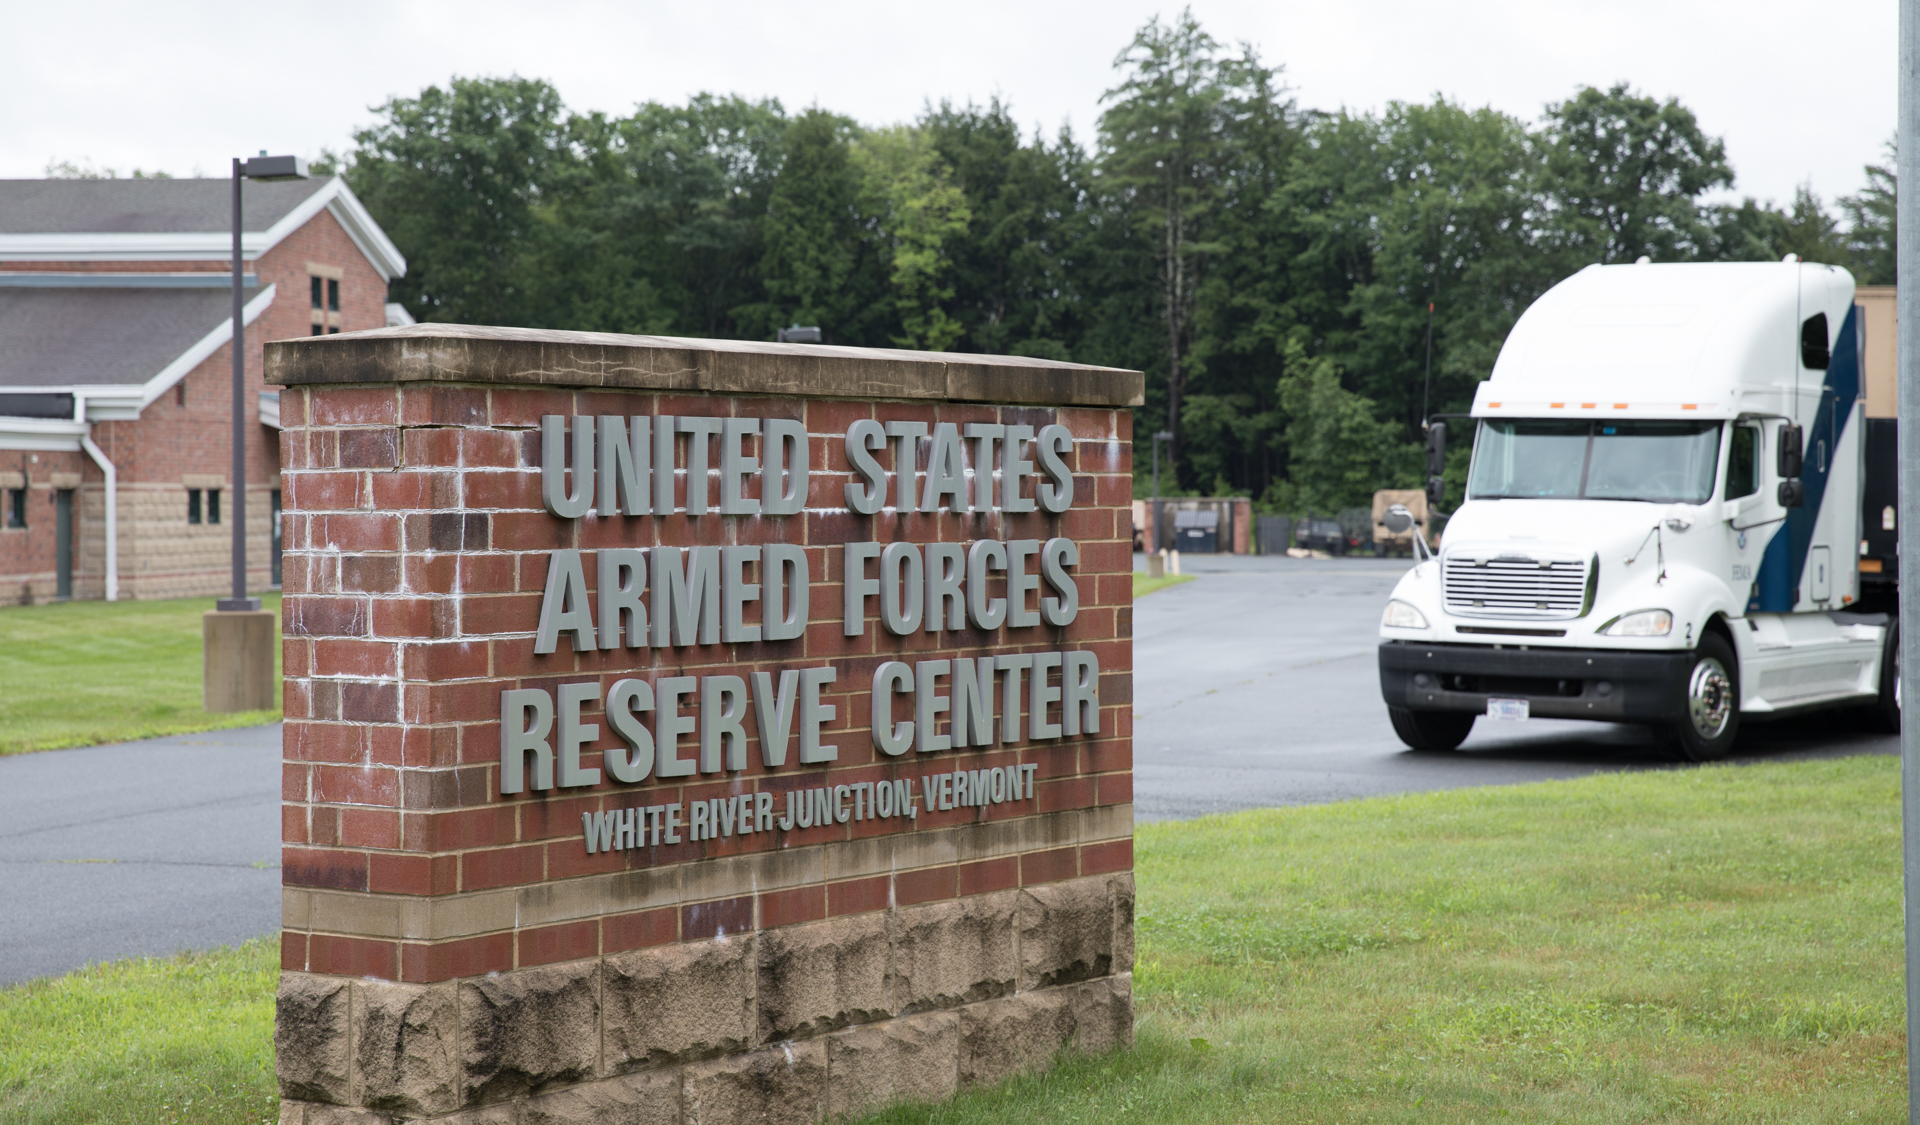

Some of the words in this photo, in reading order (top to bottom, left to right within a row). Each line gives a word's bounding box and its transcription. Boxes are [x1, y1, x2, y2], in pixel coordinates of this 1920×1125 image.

[541, 414, 810, 519] UNITED
[844, 419, 1074, 515] STATES
[534, 543, 810, 655] ARMED
[844, 537, 1079, 636] FORCES
[500, 666, 838, 795] RESERVE
[872, 651, 1100, 756] CENTER
[582, 802, 682, 854] WHITE
[689, 792, 773, 842] RIVER
[778, 778, 918, 831] JUNCTION,
[921, 763, 1038, 812] VERMONT
